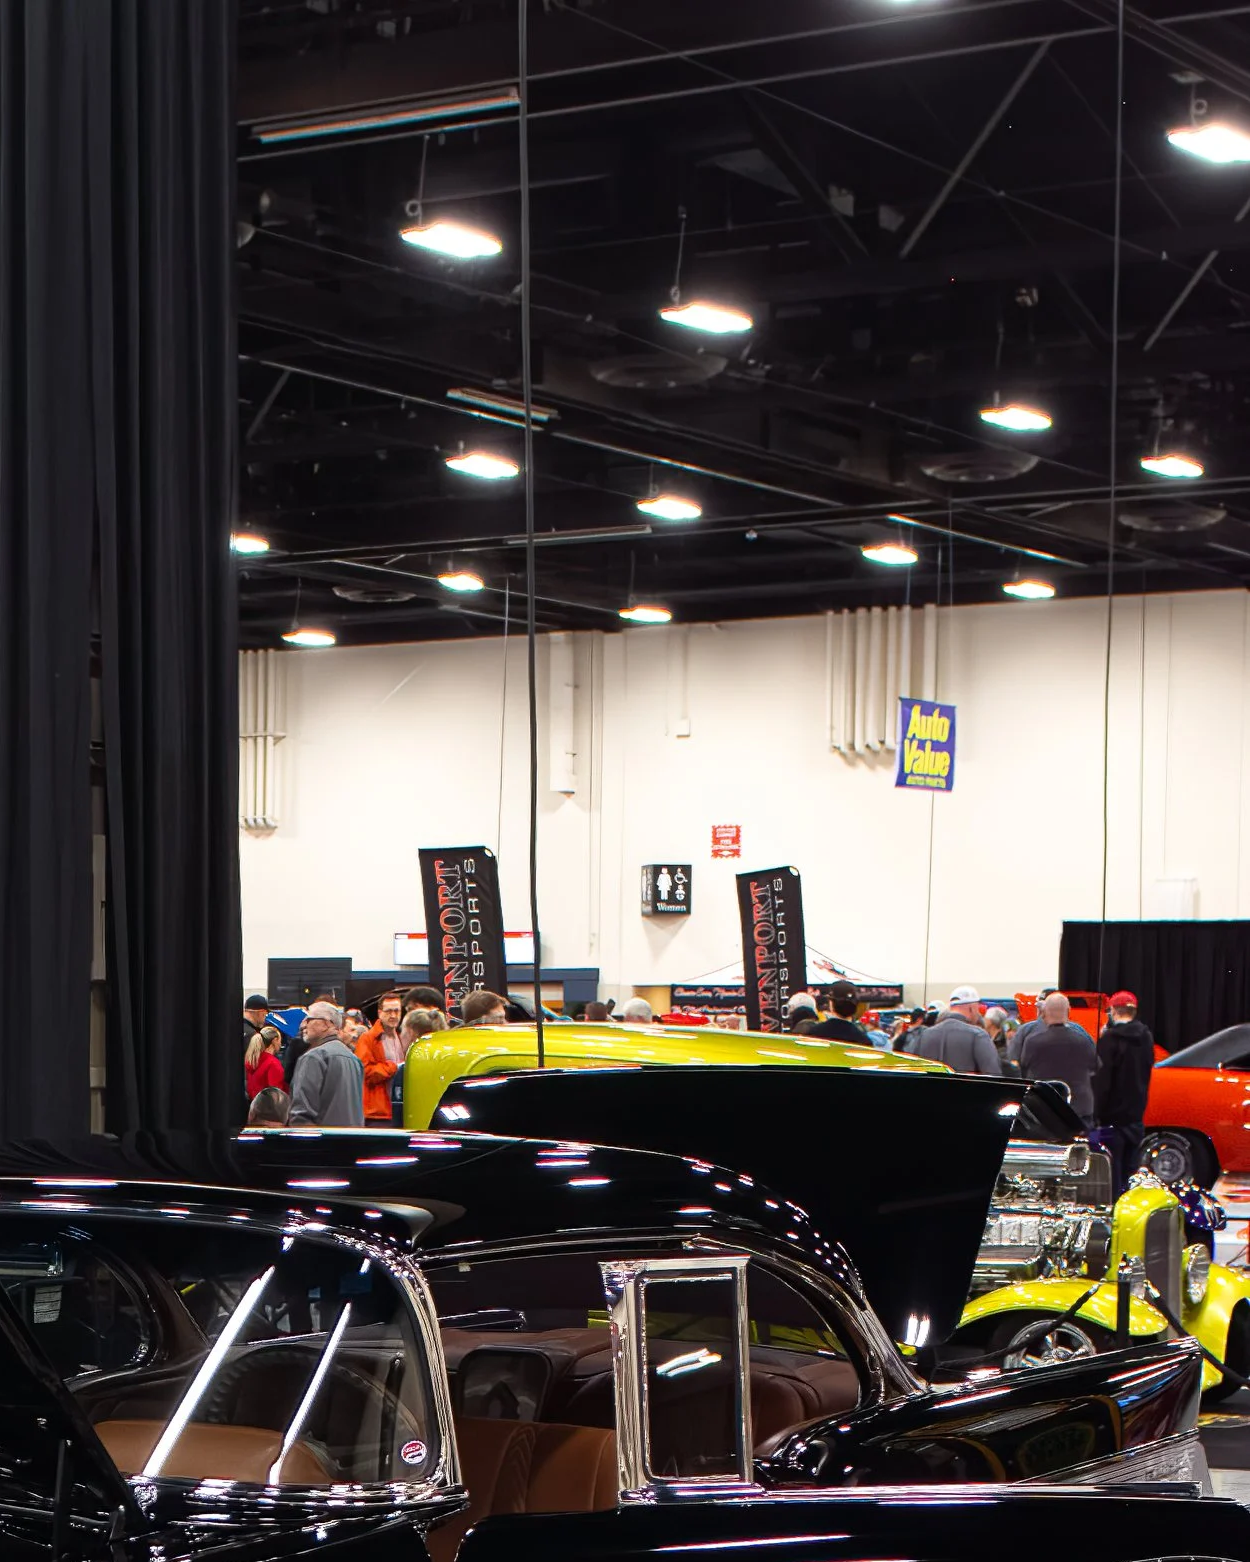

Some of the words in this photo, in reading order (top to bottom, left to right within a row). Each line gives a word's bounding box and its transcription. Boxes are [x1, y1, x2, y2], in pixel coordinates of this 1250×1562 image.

[907, 704, 950, 742] Auto
[904, 739, 950, 777] Value
[657, 902, 687, 912] Women
